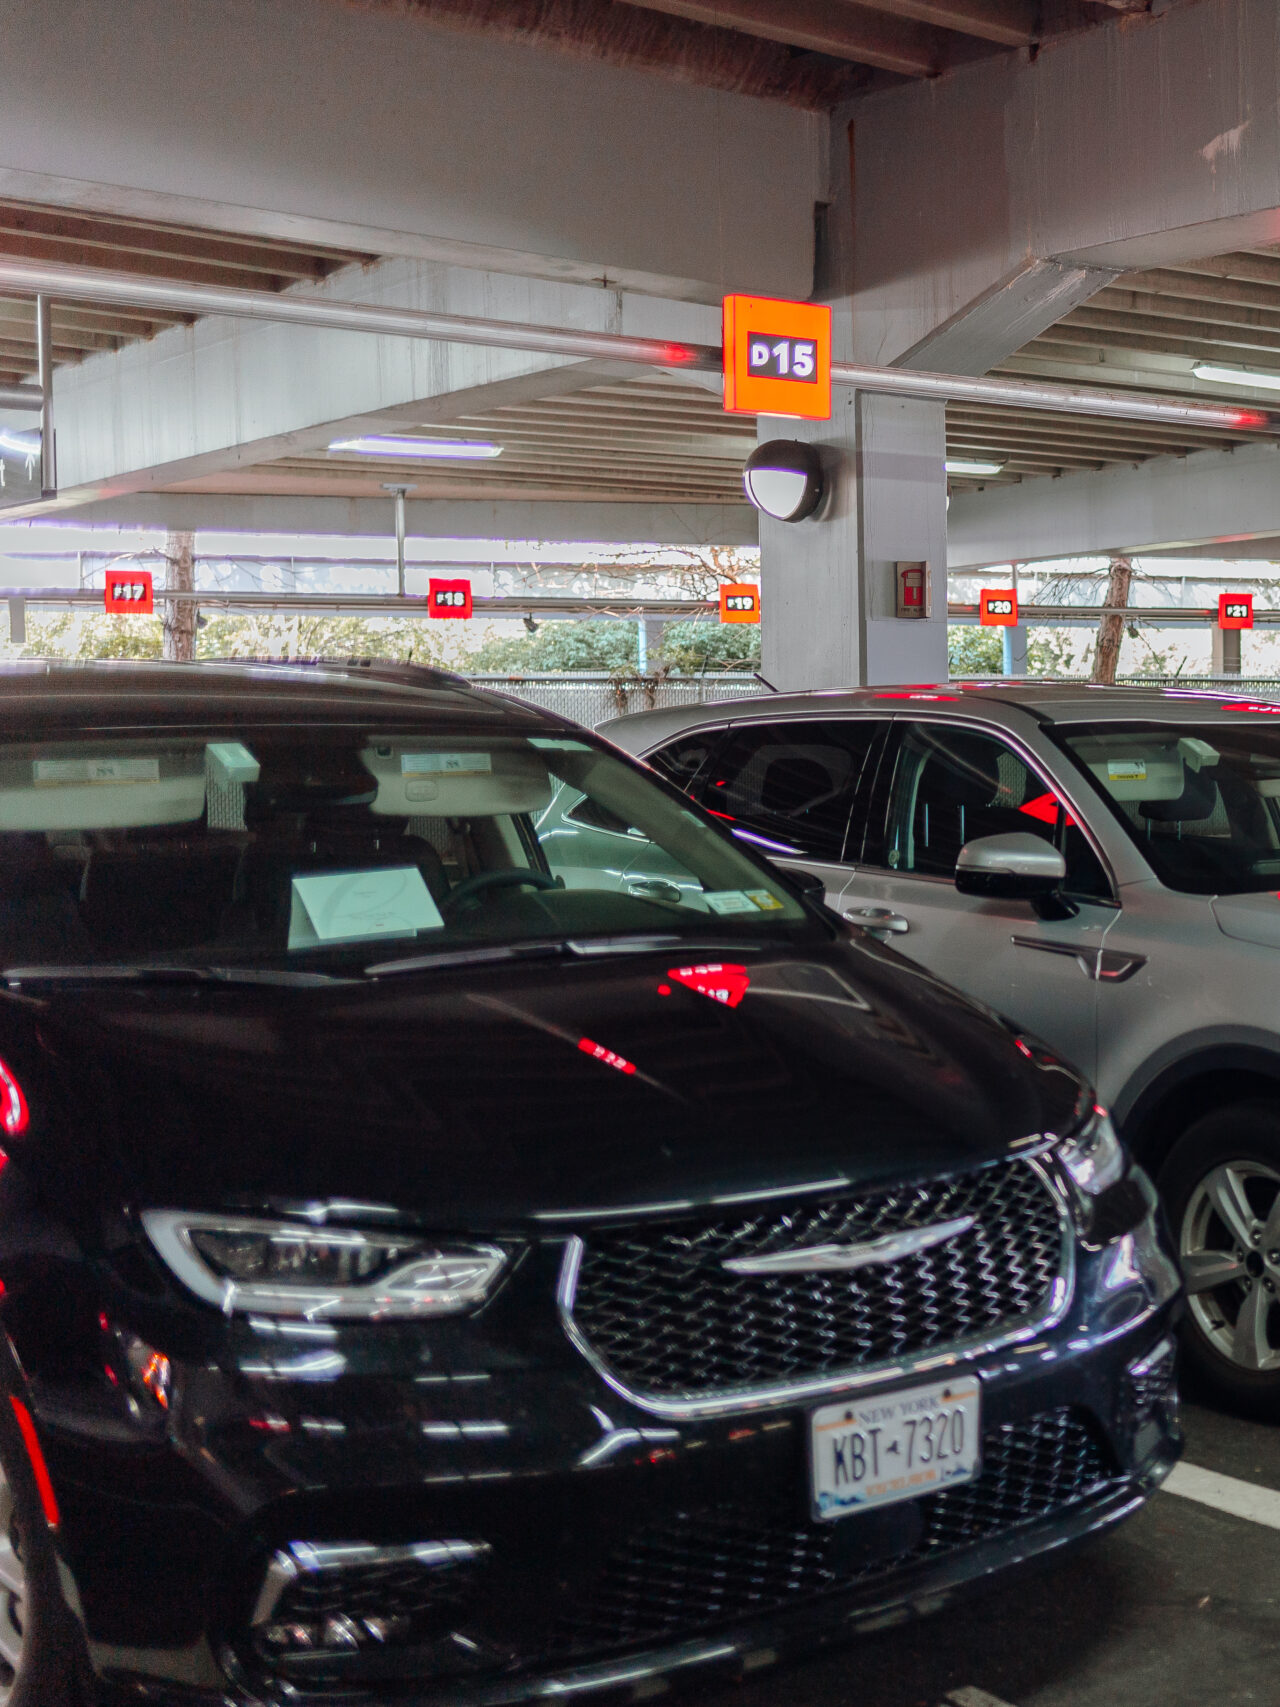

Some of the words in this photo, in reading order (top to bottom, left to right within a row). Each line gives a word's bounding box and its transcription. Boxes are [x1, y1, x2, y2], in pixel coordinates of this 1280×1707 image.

[750, 339, 814, 378] D15
[113, 583, 145, 601] F17
[436, 592, 465, 606] F18
[727, 597, 754, 610] F19
[988, 600, 1012, 614] F20
[1227, 604, 1247, 617] F21
[859, 1407, 895, 1424] NEW
[900, 1397, 941, 1415] YORK
